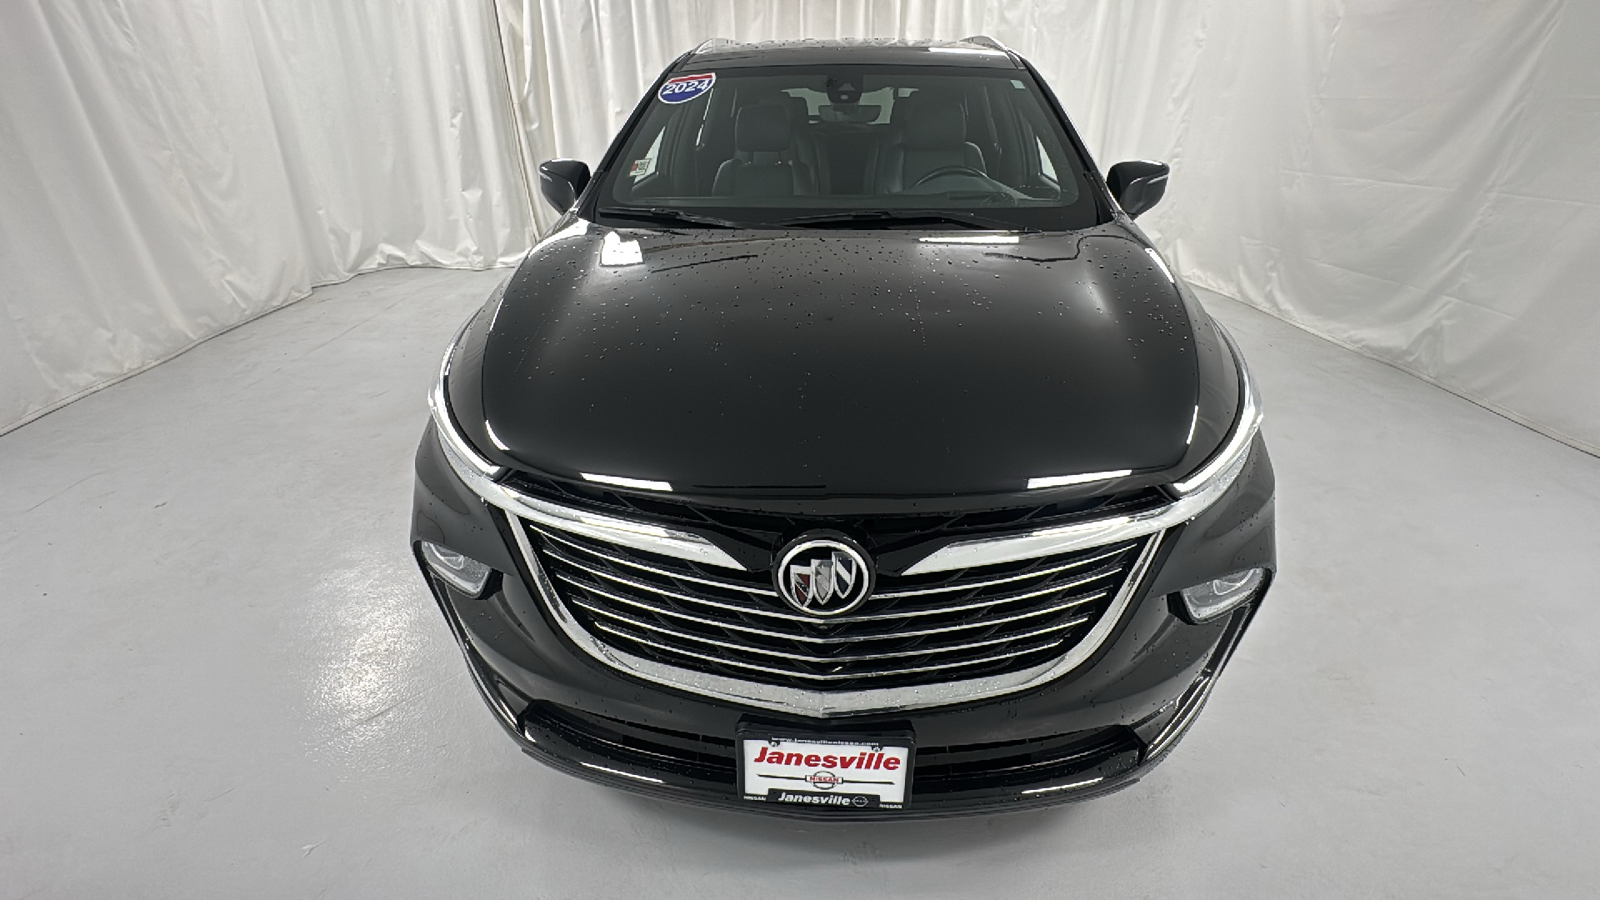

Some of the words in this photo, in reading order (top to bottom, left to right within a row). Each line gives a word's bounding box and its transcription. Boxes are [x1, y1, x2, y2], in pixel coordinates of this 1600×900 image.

[662, 80, 709, 95] 2024
[754, 746, 901, 771] Janesville
[809, 775, 839, 783] NISSAN
[778, 792, 851, 806] Janesville
